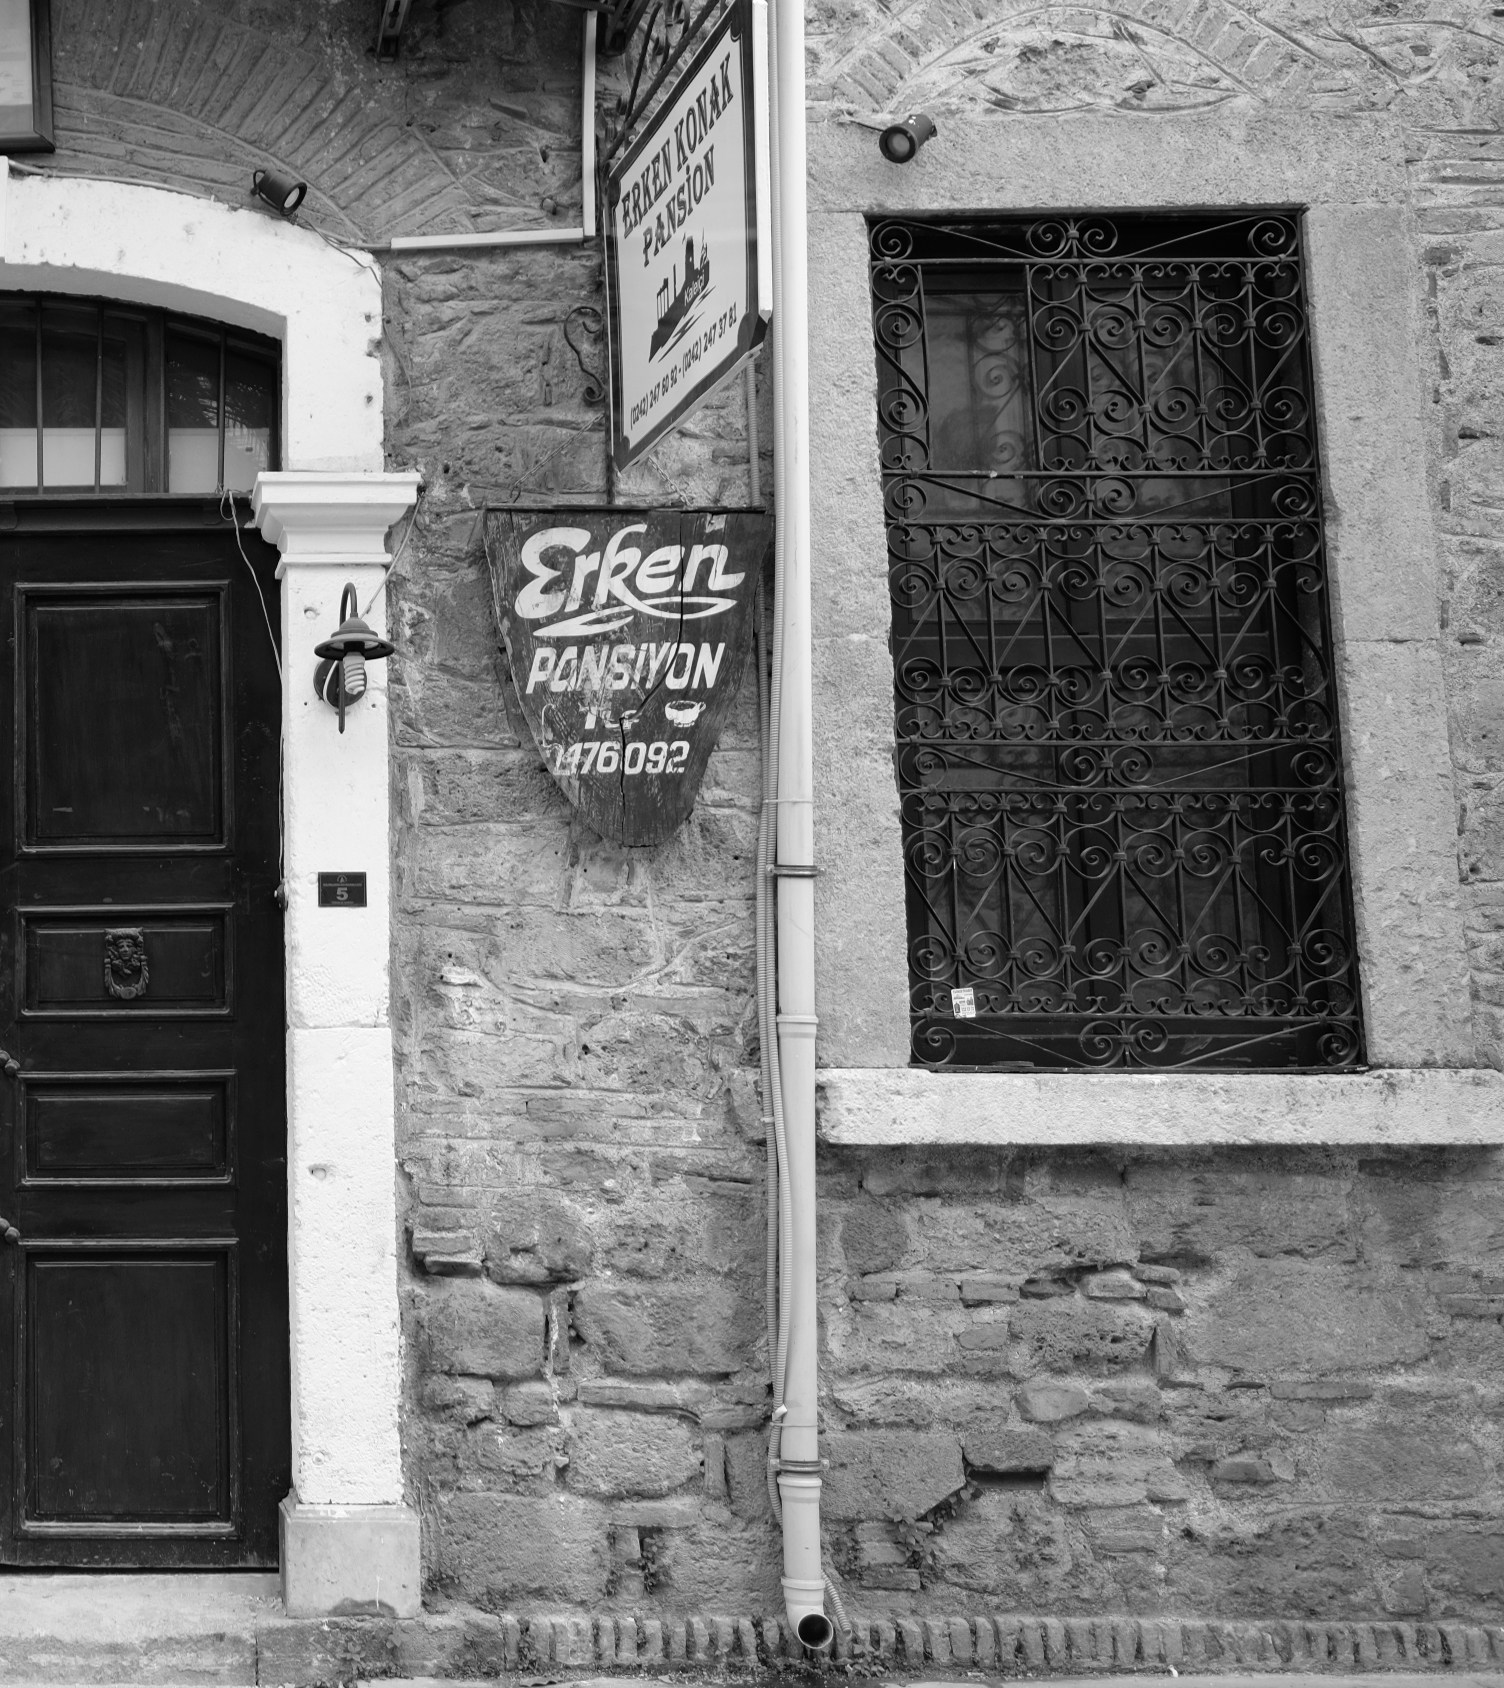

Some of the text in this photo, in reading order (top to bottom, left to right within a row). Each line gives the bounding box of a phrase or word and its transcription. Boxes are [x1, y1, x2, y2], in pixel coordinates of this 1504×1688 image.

[621, 52, 734, 239] ERKEN KONAK
[630, 393, 649, 431] (0242)
[649, 382, 661, 409] 247
[682, 335, 701, 379] (0242)
[703, 321, 717, 354] 247
[514, 523, 746, 630] Erken
[336, 887, 349, 901] 5
